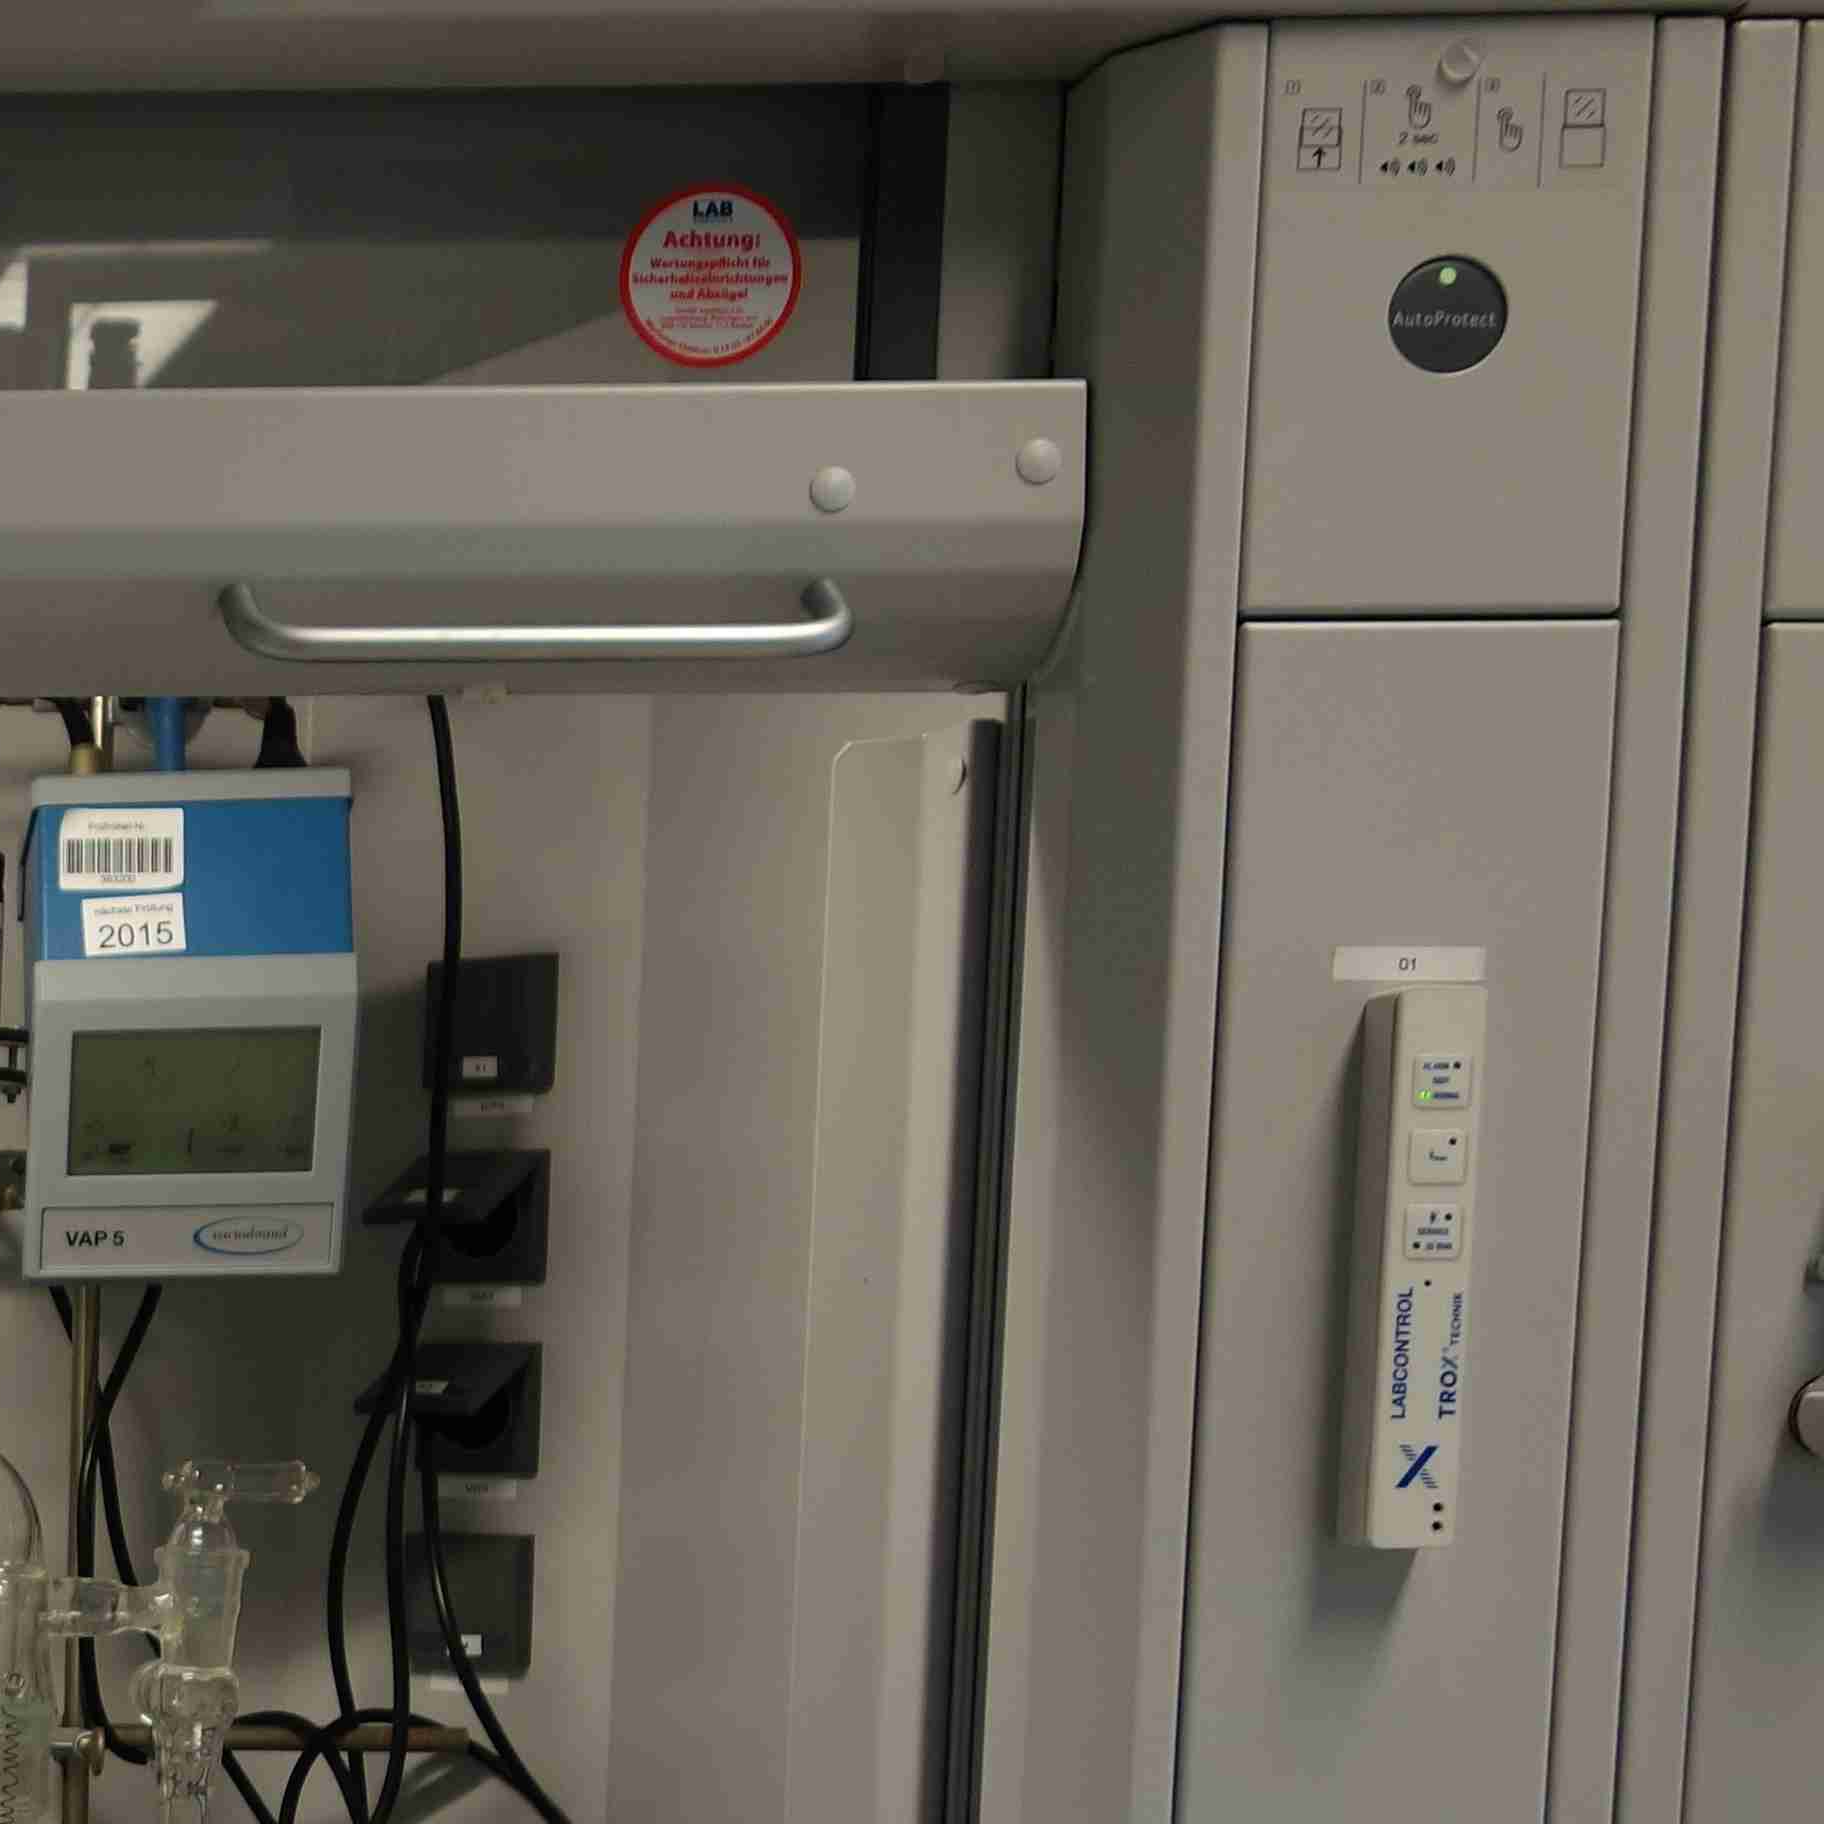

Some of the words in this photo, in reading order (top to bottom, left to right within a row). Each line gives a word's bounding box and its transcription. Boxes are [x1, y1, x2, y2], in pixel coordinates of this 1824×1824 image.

[693, 201, 733, 217] LAB
[1392, 311, 1497, 329] AutoProtect
[98, 920, 173, 948] 2015
[65, 1230, 107, 1247] VAP
[113, 1230, 125, 1246] 5
[1450, 1292, 1462, 1345] TECHNIK
[1391, 1286, 1413, 1420] LABCONTROL
